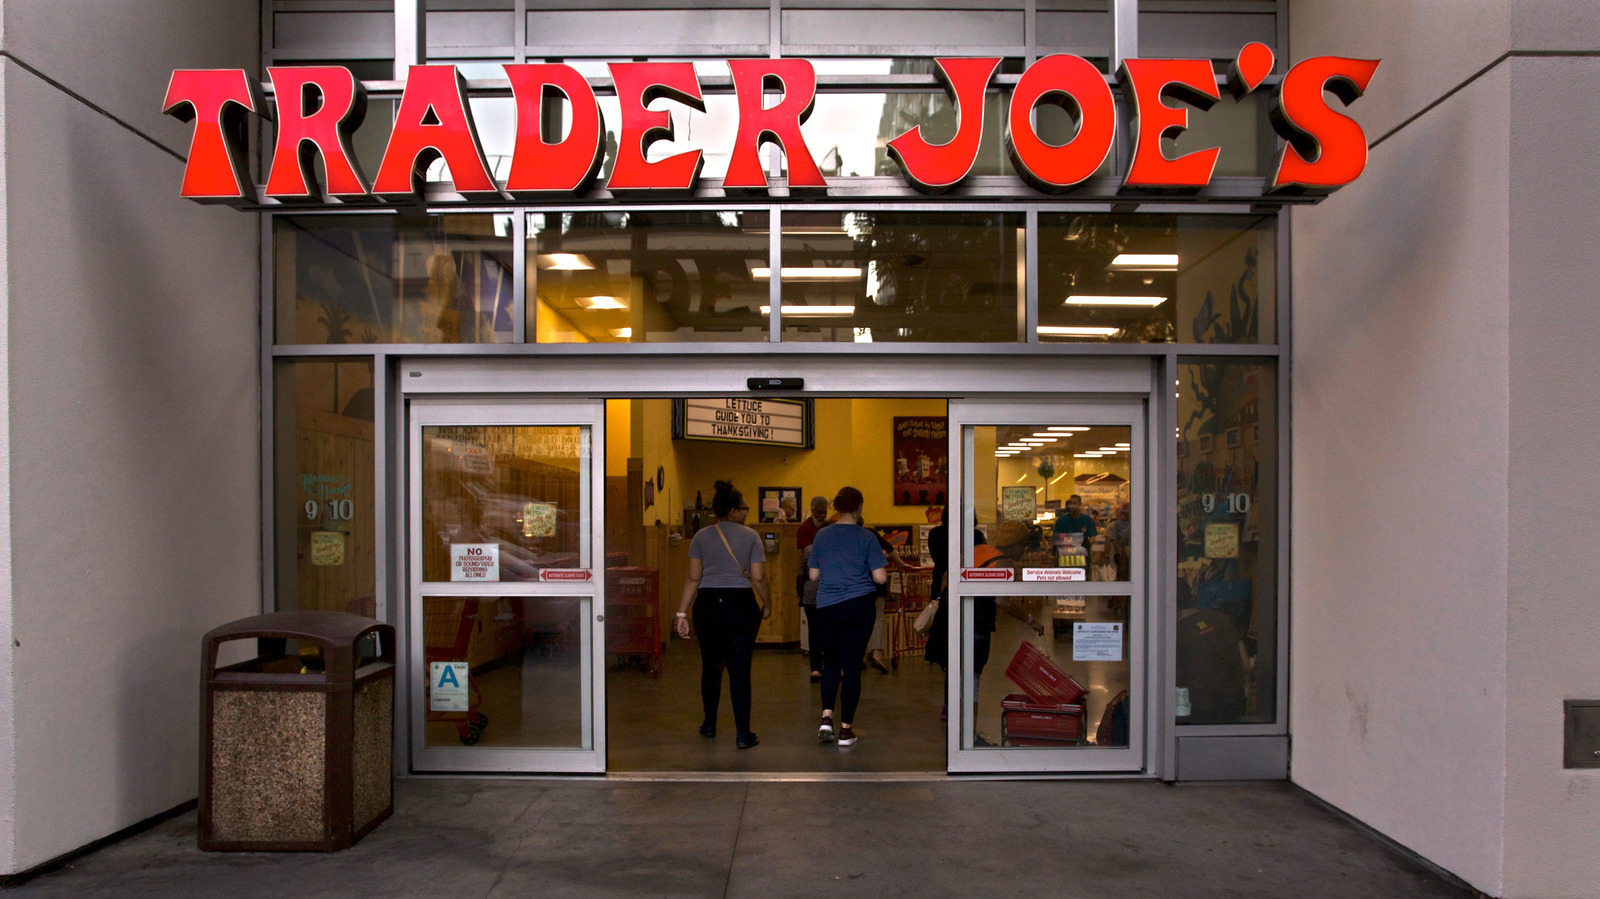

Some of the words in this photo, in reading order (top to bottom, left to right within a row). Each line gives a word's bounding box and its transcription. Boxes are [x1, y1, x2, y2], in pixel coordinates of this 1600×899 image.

[163, 58, 828, 202] TRADER
[886, 41, 1382, 198] JOE'S
[725, 398, 762, 412] LETTUCE
[715, 410, 739, 422] GUIDE
[741, 413, 757, 424] YOU
[760, 415, 770, 426] TO
[304, 500, 318, 520] 9
[329, 499, 354, 520] 10
[1202, 493, 1215, 513] 9
[1226, 493, 1250, 513] 10
[467, 548, 483, 556] NO
[438, 665, 460, 688] A
